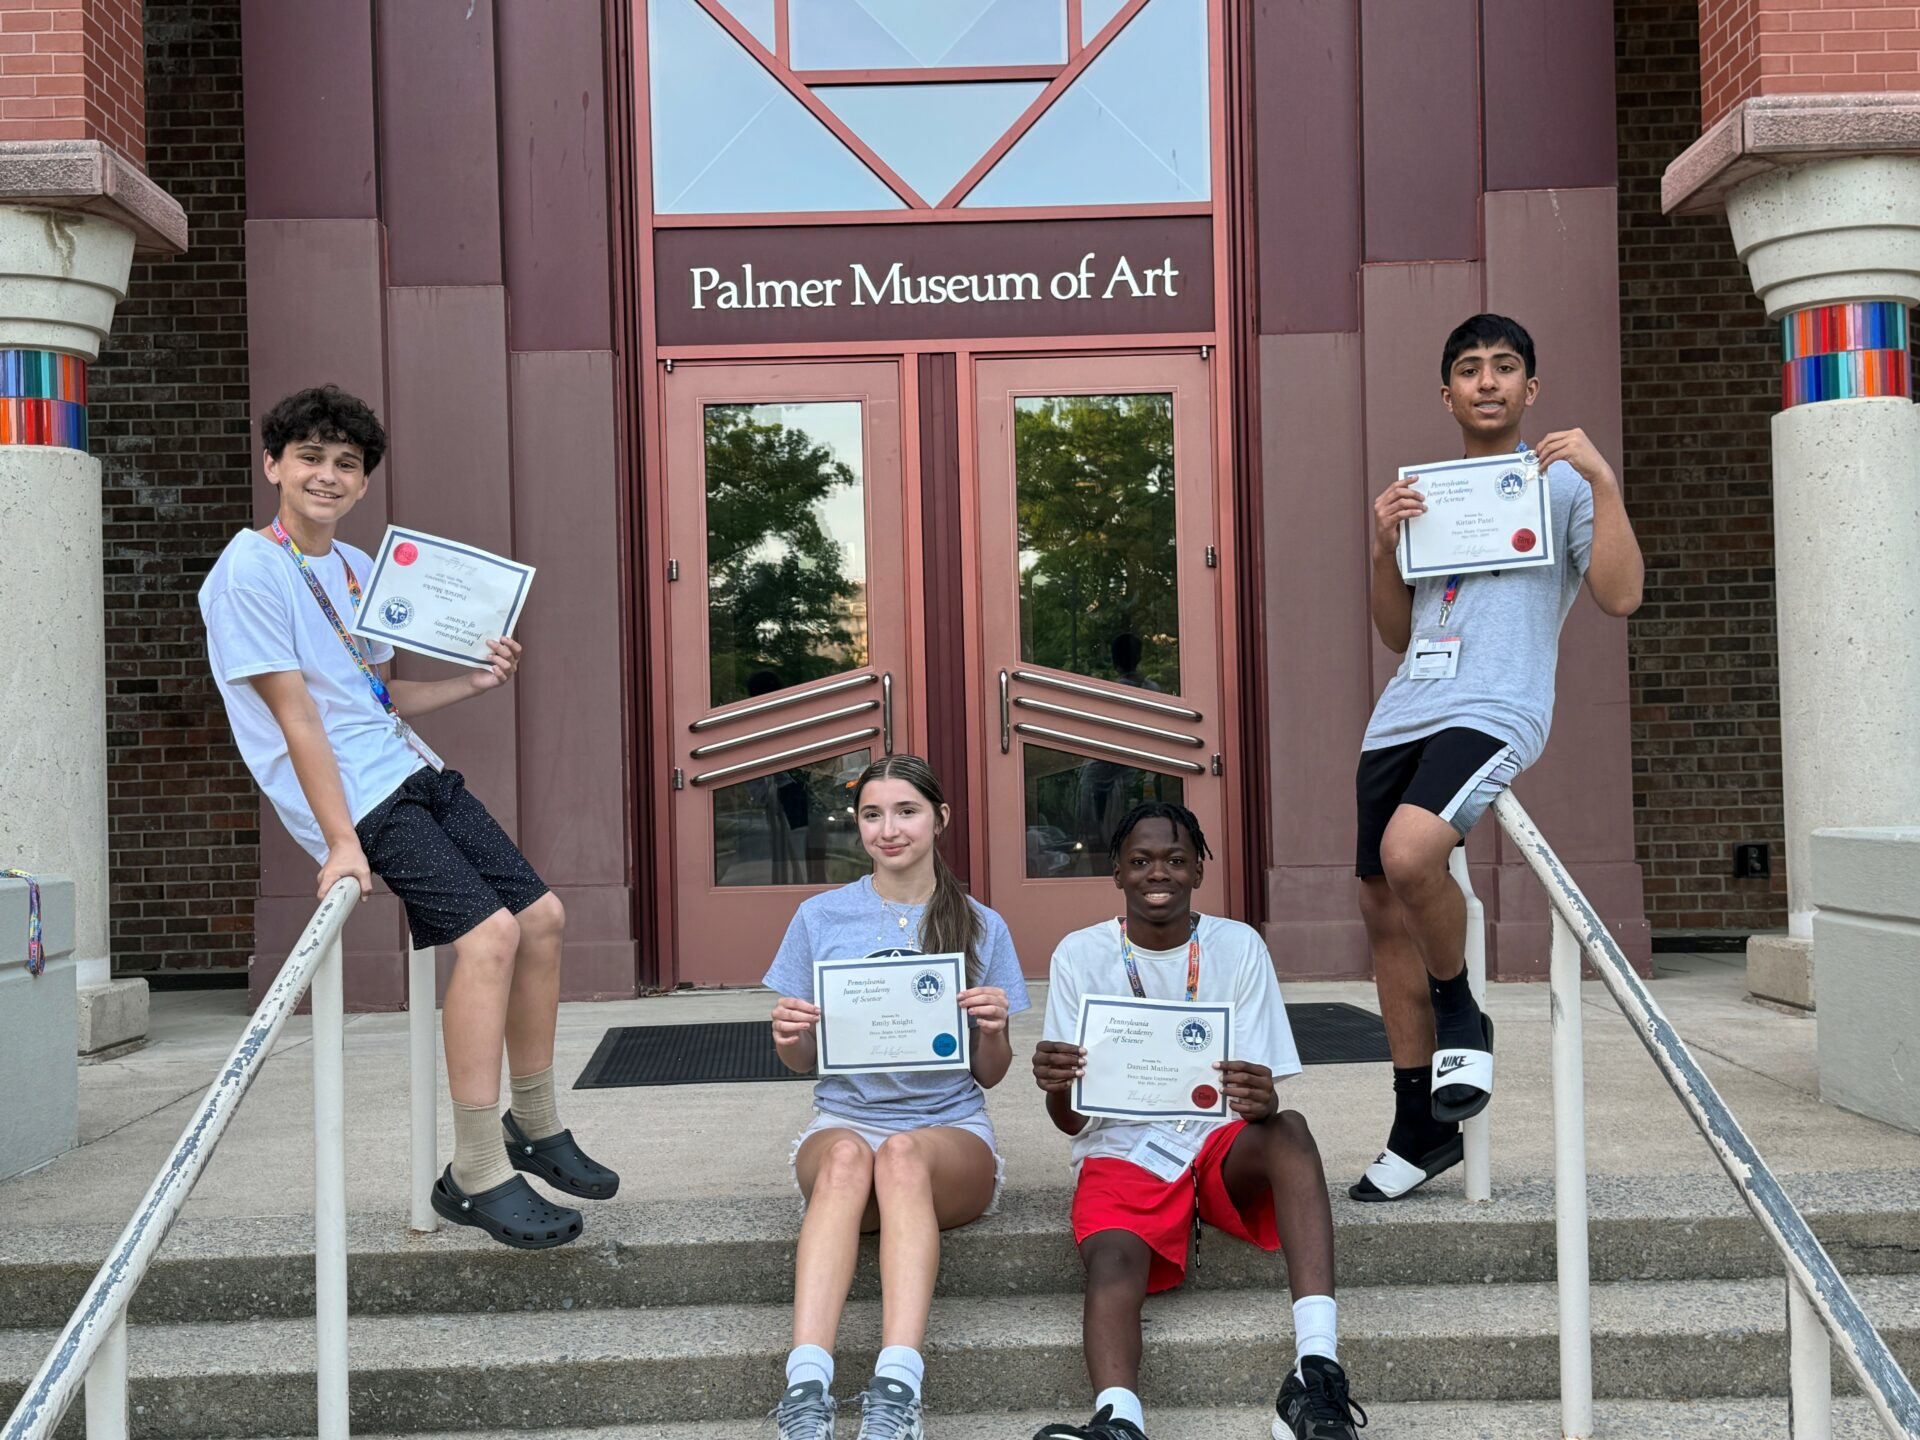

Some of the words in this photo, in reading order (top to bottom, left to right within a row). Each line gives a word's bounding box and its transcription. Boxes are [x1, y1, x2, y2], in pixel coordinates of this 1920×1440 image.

[690, 264, 842, 309] Palmer
[850, 263, 1042, 306] Museum
[1050, 252, 1095, 300] of
[1102, 255, 1179, 299] Art
[1431, 479, 1470, 489] Pennsylvania
[847, 979, 886, 988] Pennsylvania
[871, 1019, 890, 1028] Emily
[891, 1018, 914, 1027] Knight
[1109, 1017, 1150, 1028] Pennsylvania
[1124, 1027, 1154, 1037] Academy
[1121, 1035, 1144, 1045] Science
[1126, 1063, 1149, 1071] Daniel
[1441, 1056, 1467, 1068] NIKE
